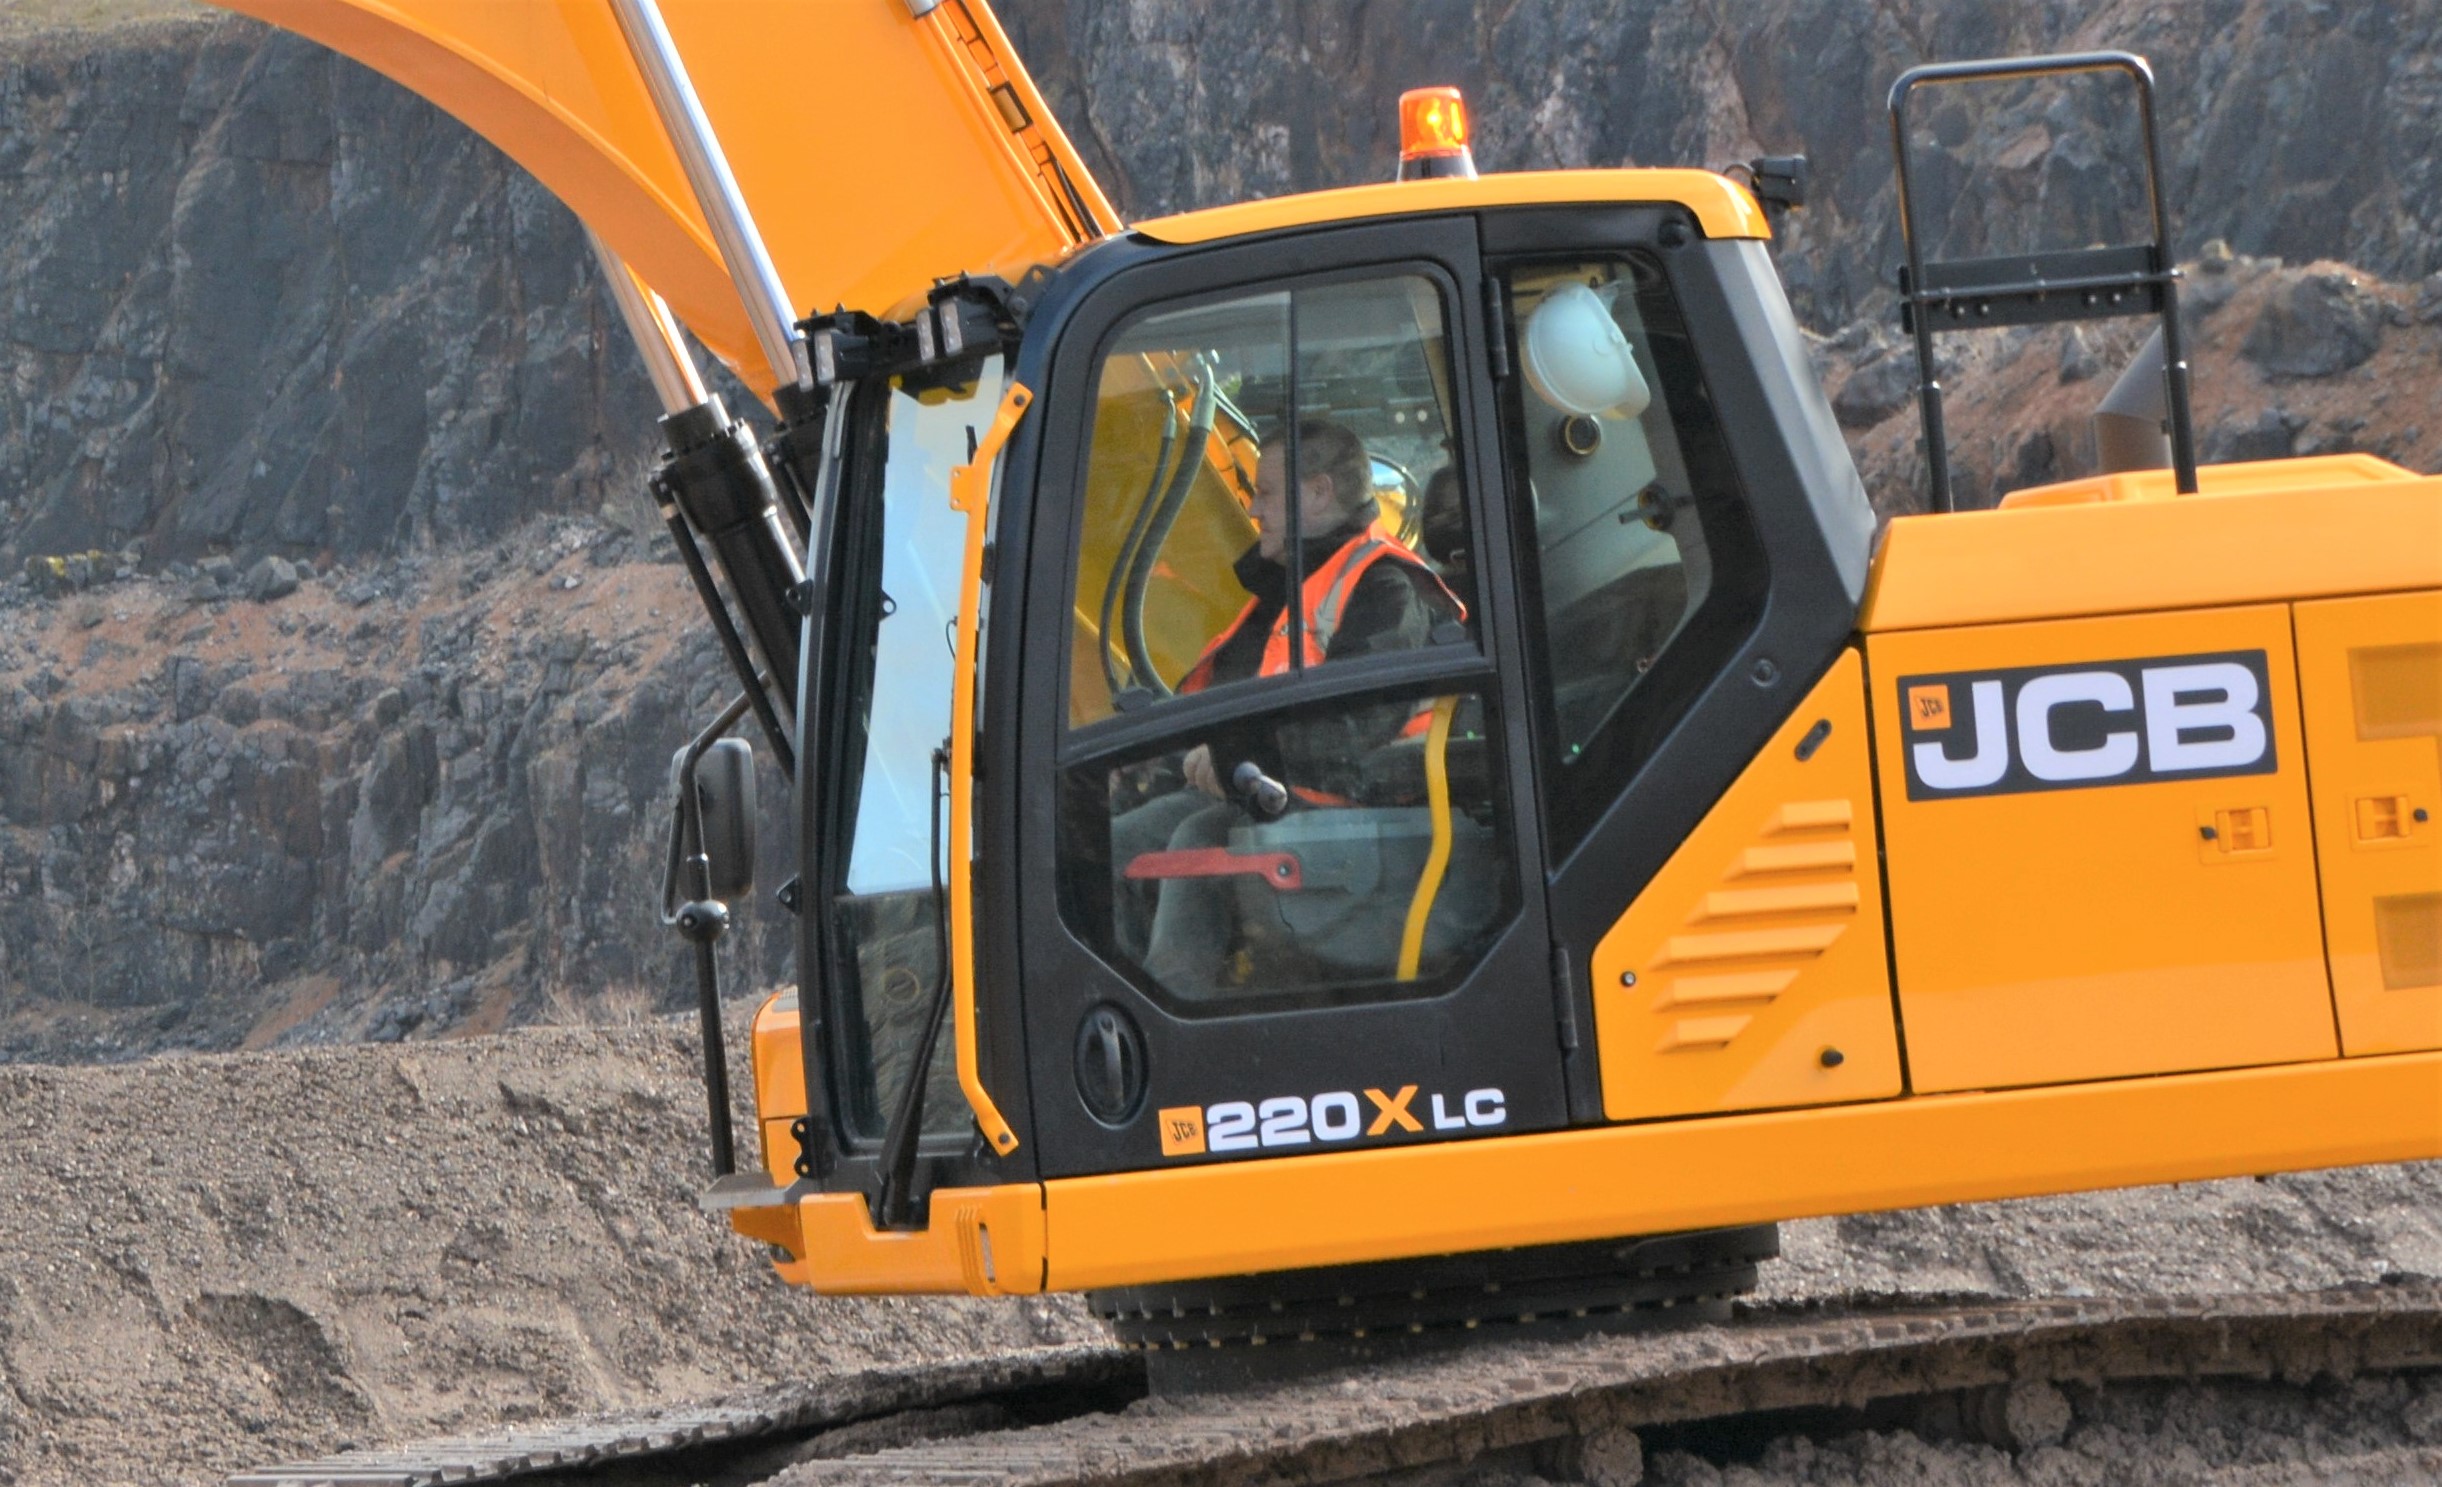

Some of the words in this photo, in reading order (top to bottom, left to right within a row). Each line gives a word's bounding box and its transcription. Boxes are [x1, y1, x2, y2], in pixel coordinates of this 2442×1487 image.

[1920, 697, 1943, 717] JCB
[1913, 662, 2266, 789] JCB
[1431, 1088, 1506, 1130] LC
[1172, 1120, 1197, 1141] JCB
